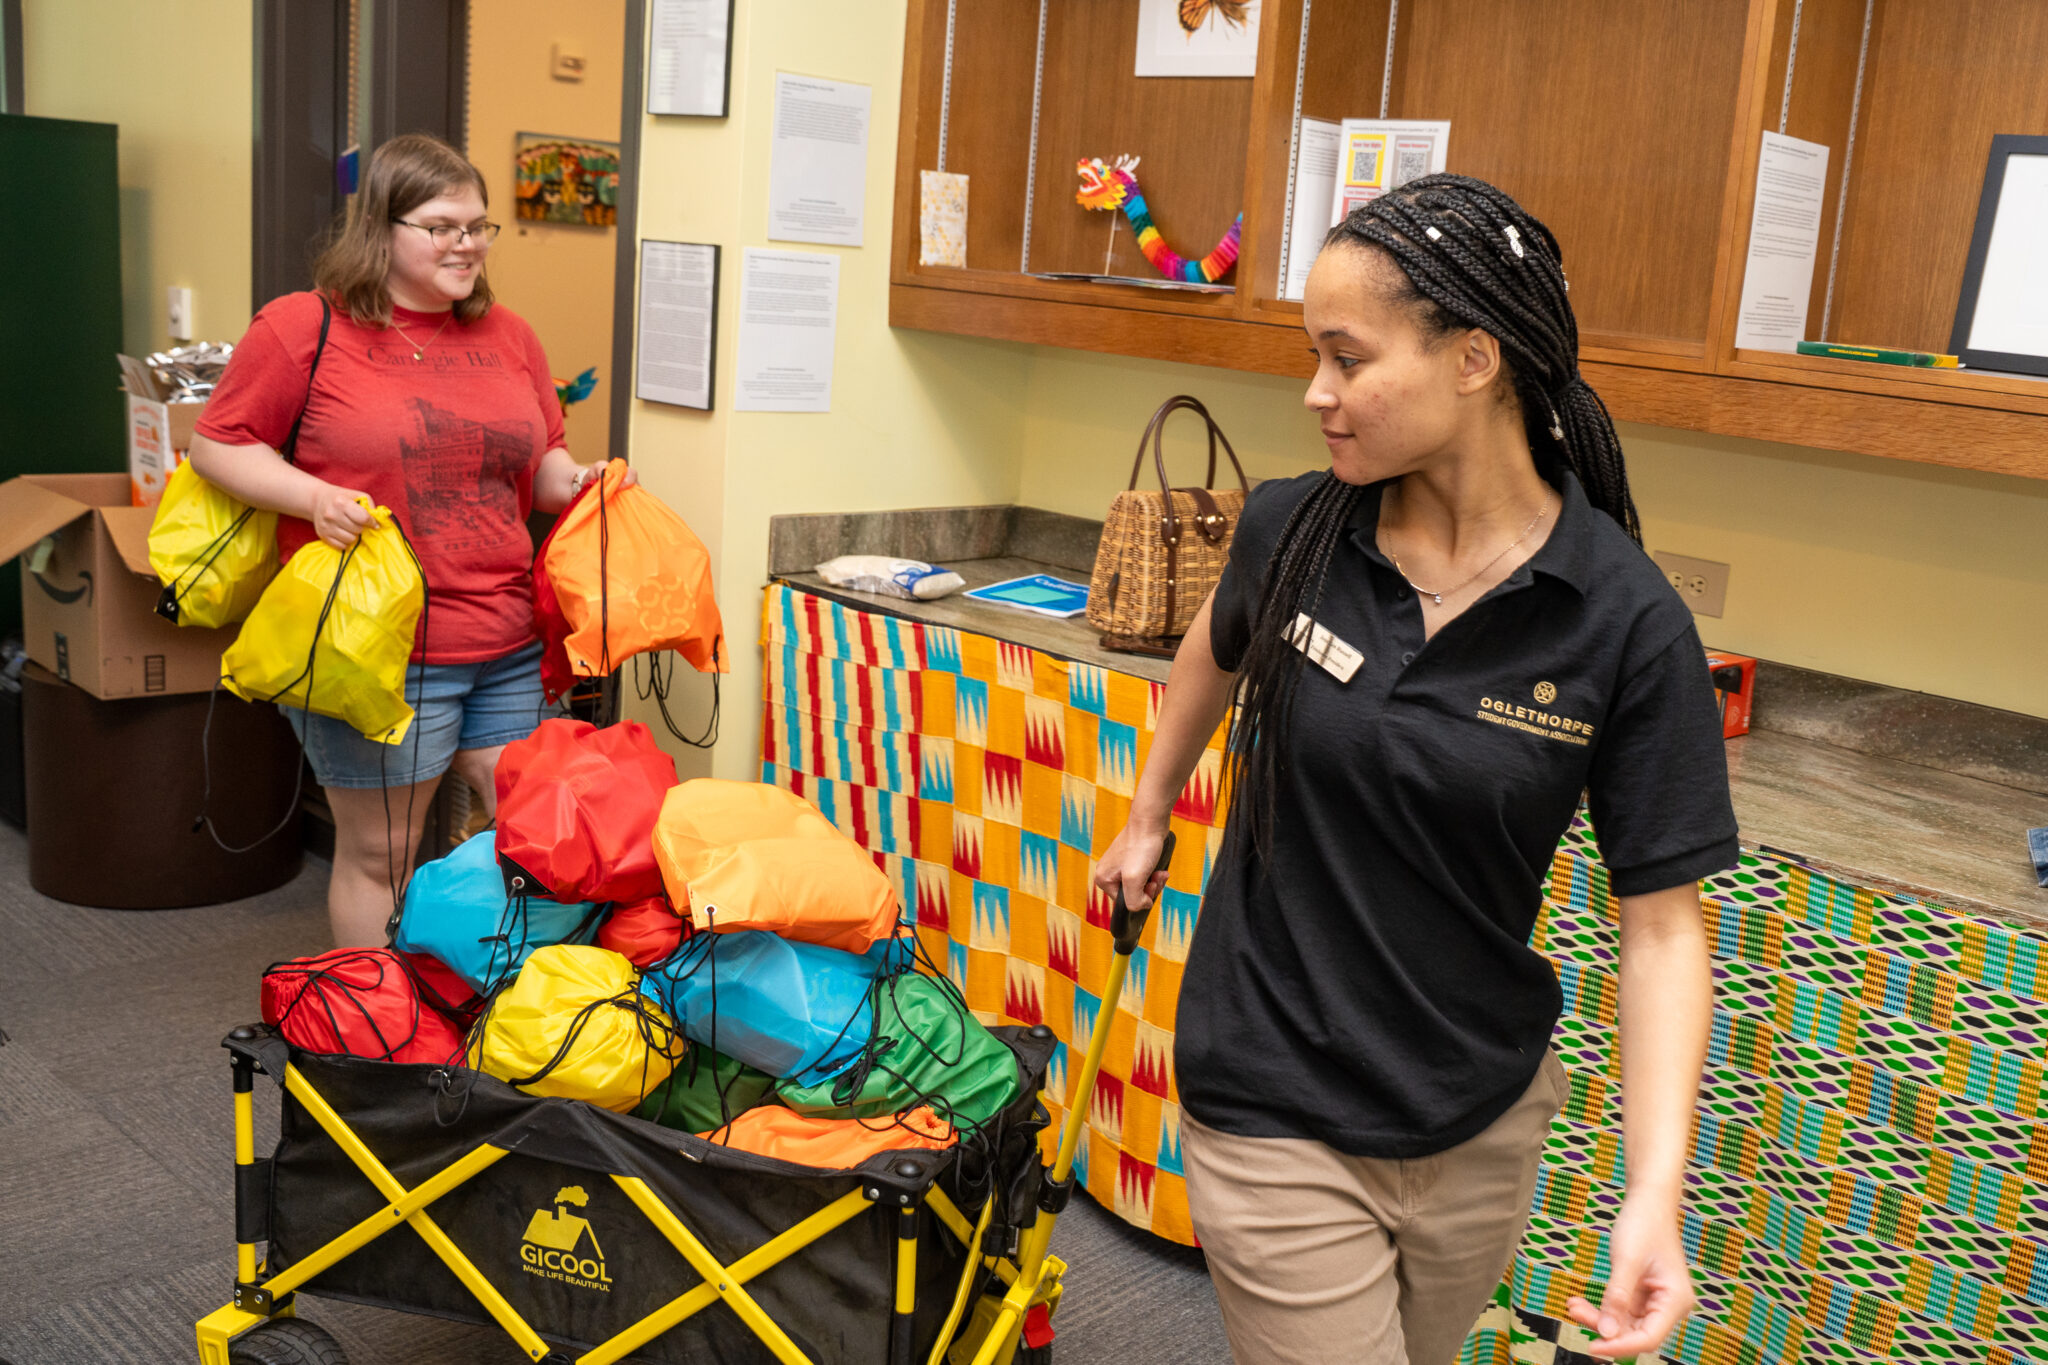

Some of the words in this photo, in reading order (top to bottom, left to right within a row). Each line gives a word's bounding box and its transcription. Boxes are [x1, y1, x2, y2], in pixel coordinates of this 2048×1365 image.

[367, 346, 458, 373] Carnegie
[466, 351, 502, 368] Hall
[1476, 710, 1506, 725] STUDENT
[1506, 718, 1549, 736] GOVERNMENT
[1480, 697, 1595, 736] OGLETHORPE
[520, 1243, 613, 1284] GICOOL
[522, 1264, 545, 1277] MAKE
[546, 1270, 564, 1281] LIFE
[565, 1275, 611, 1292] BEAUTIFUL
